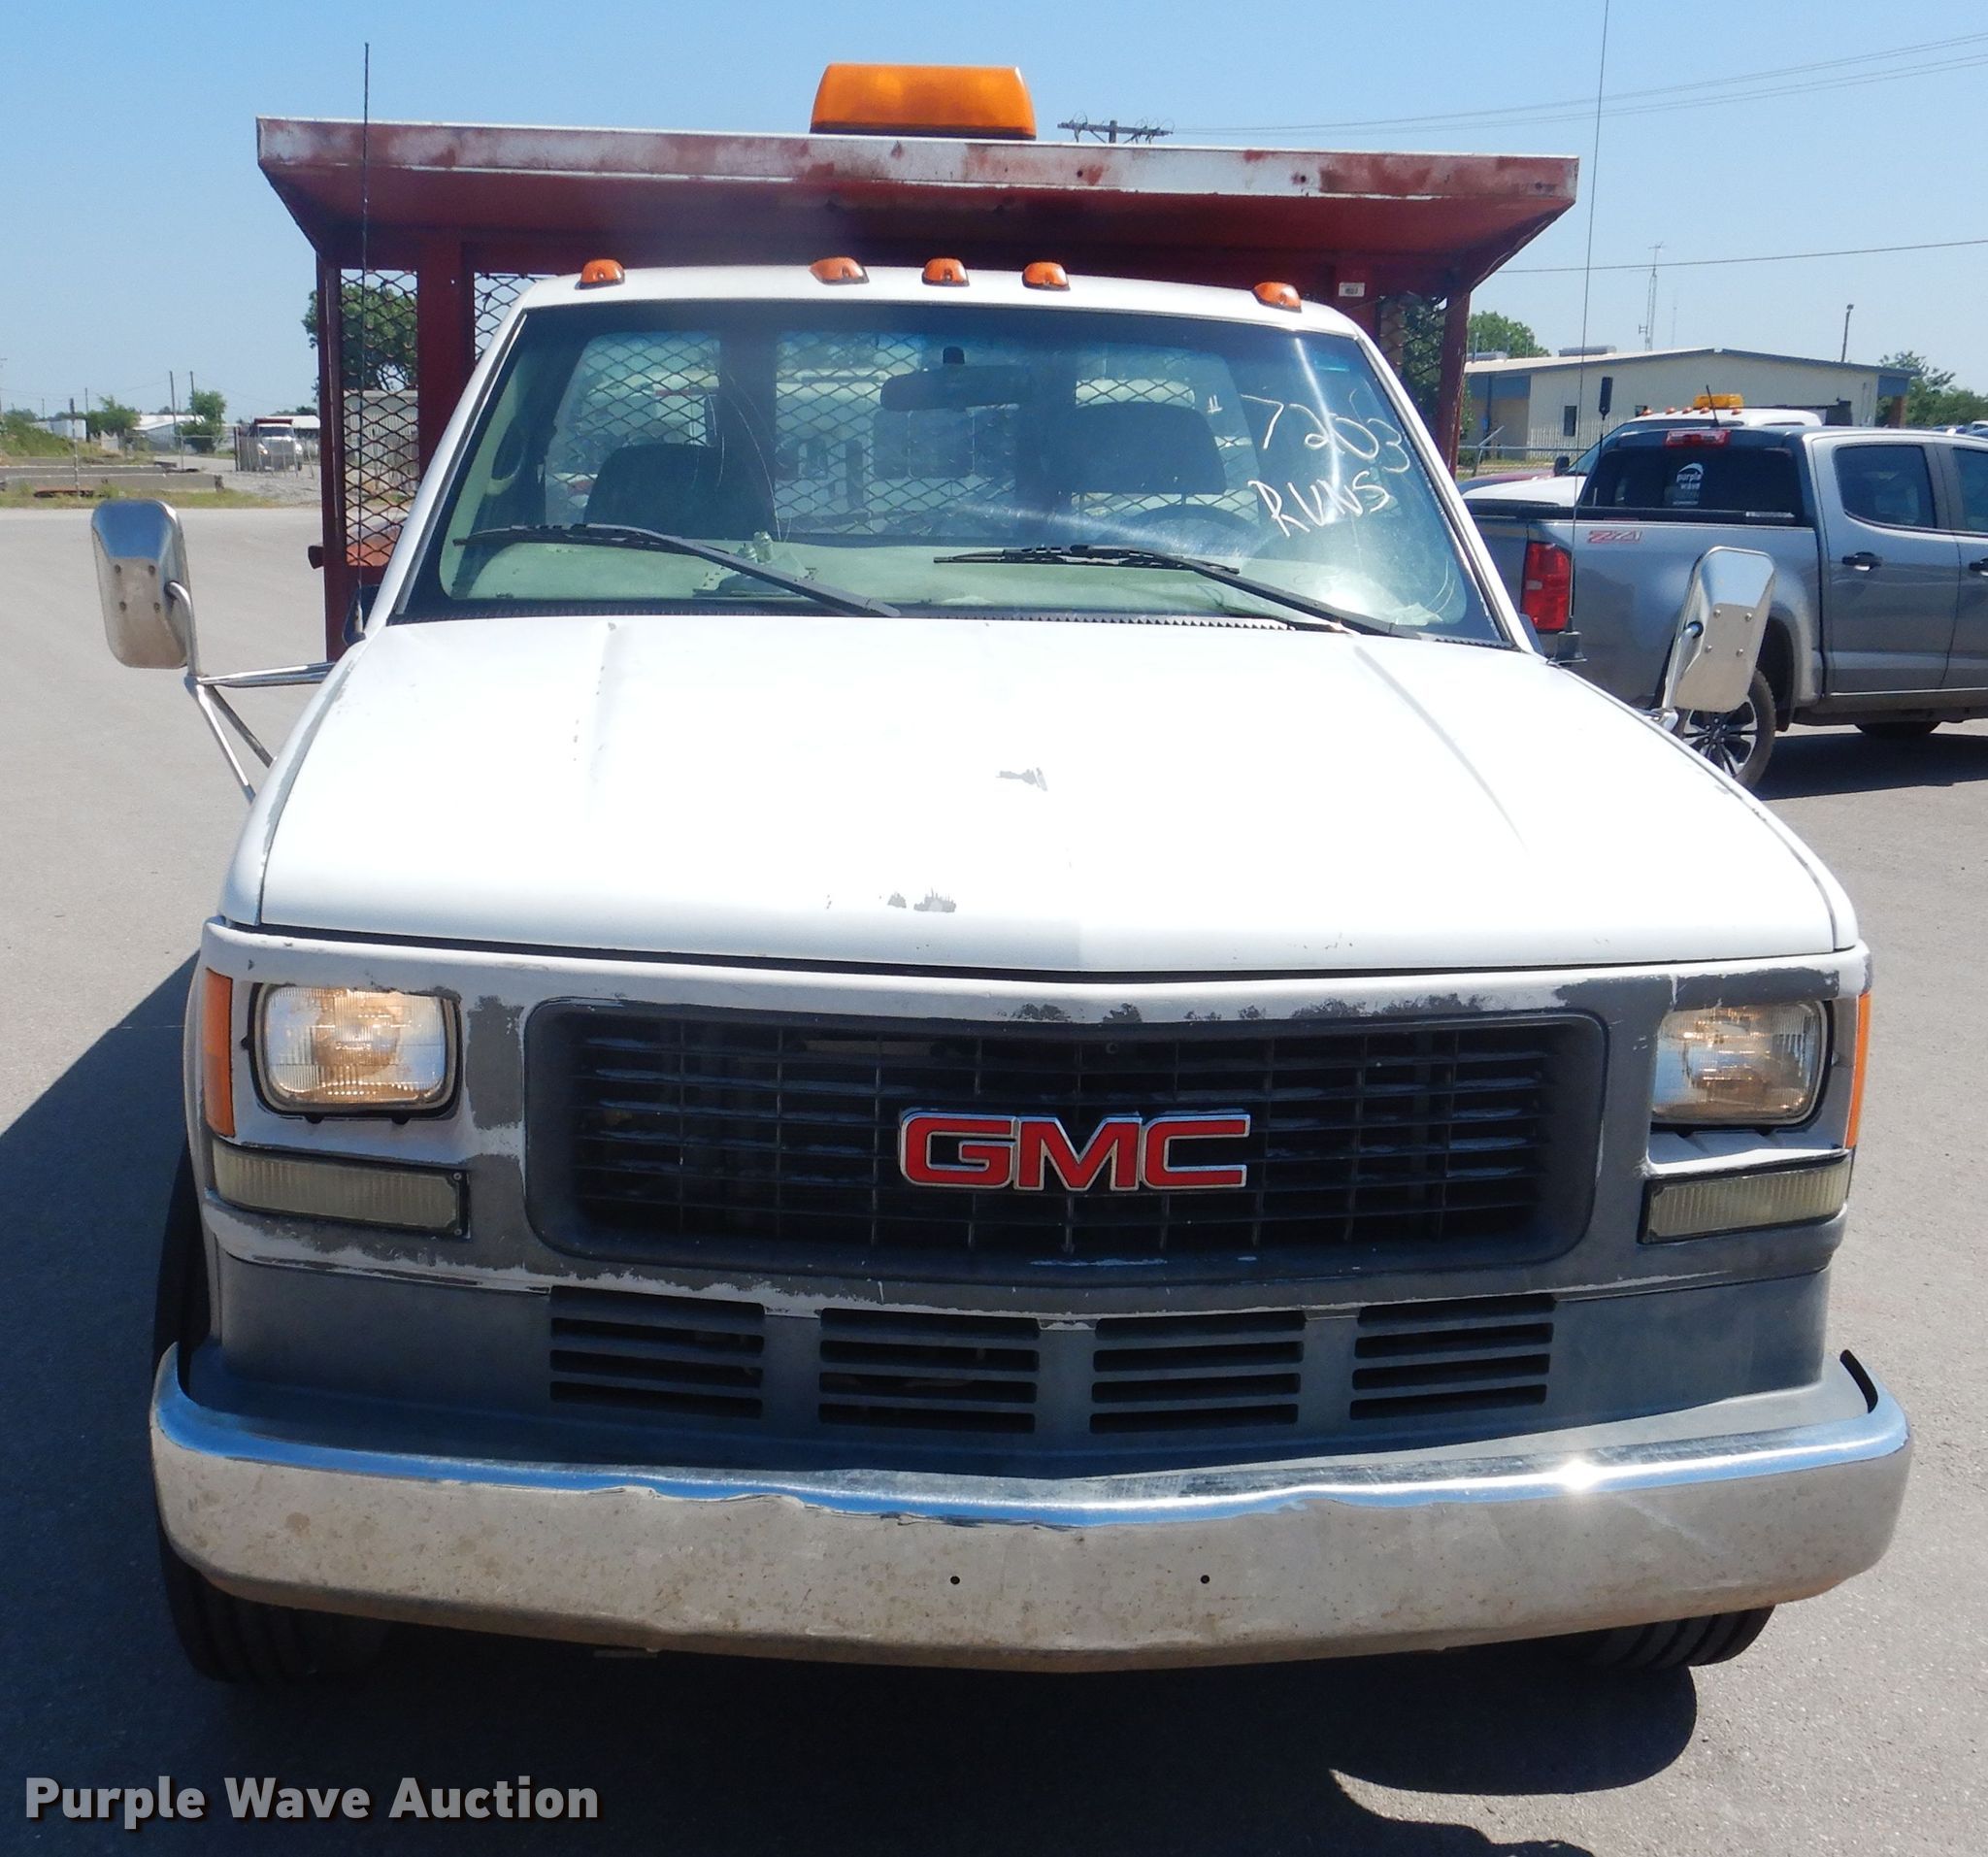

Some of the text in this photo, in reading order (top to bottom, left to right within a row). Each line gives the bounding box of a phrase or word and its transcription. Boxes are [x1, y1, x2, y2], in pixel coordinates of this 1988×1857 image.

[1240, 393, 1410, 473] 7203
[1246, 470, 1391, 537] RUNS
[900, 1111, 1250, 1191] GMC
